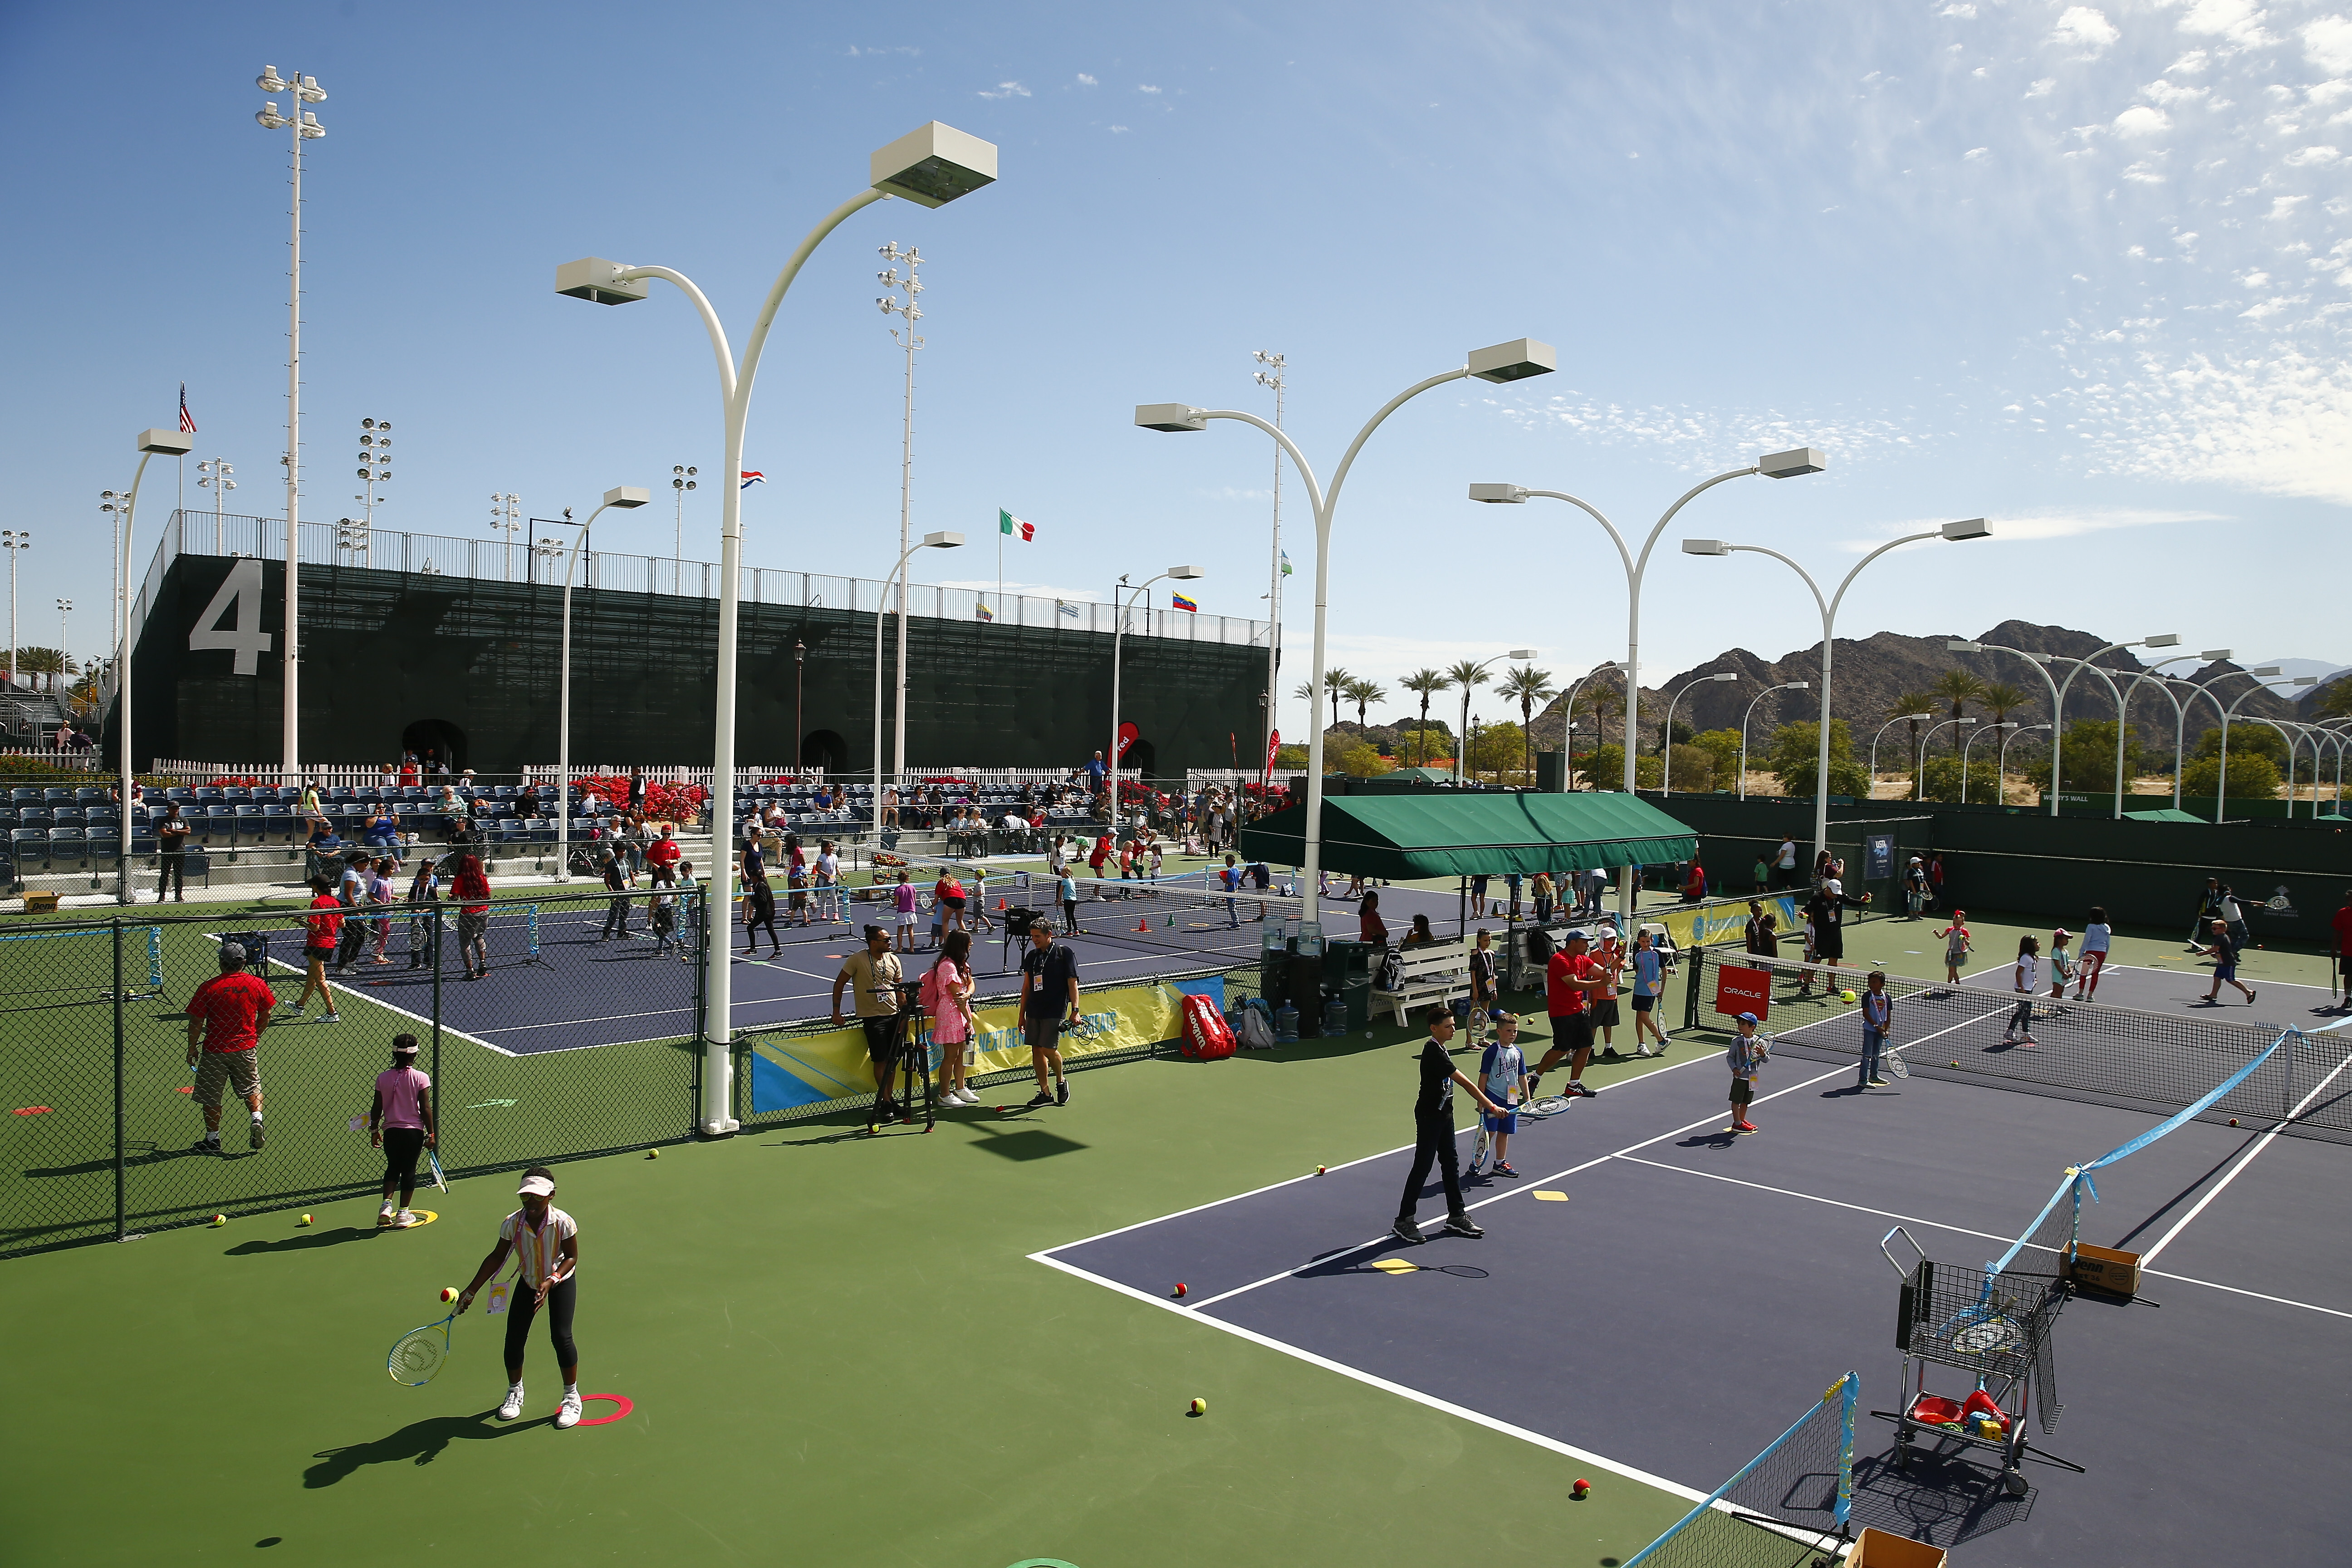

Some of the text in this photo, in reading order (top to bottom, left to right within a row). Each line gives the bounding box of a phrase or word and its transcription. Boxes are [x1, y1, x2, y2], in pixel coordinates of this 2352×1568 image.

[189, 559, 272, 675] 4
[1724, 987, 1761, 999] ORACLE
[1188, 1009, 1206, 1049] Wilson
[979, 1030, 1004, 1053] NEXT
[1993, 1409, 2005, 1421] CAL
